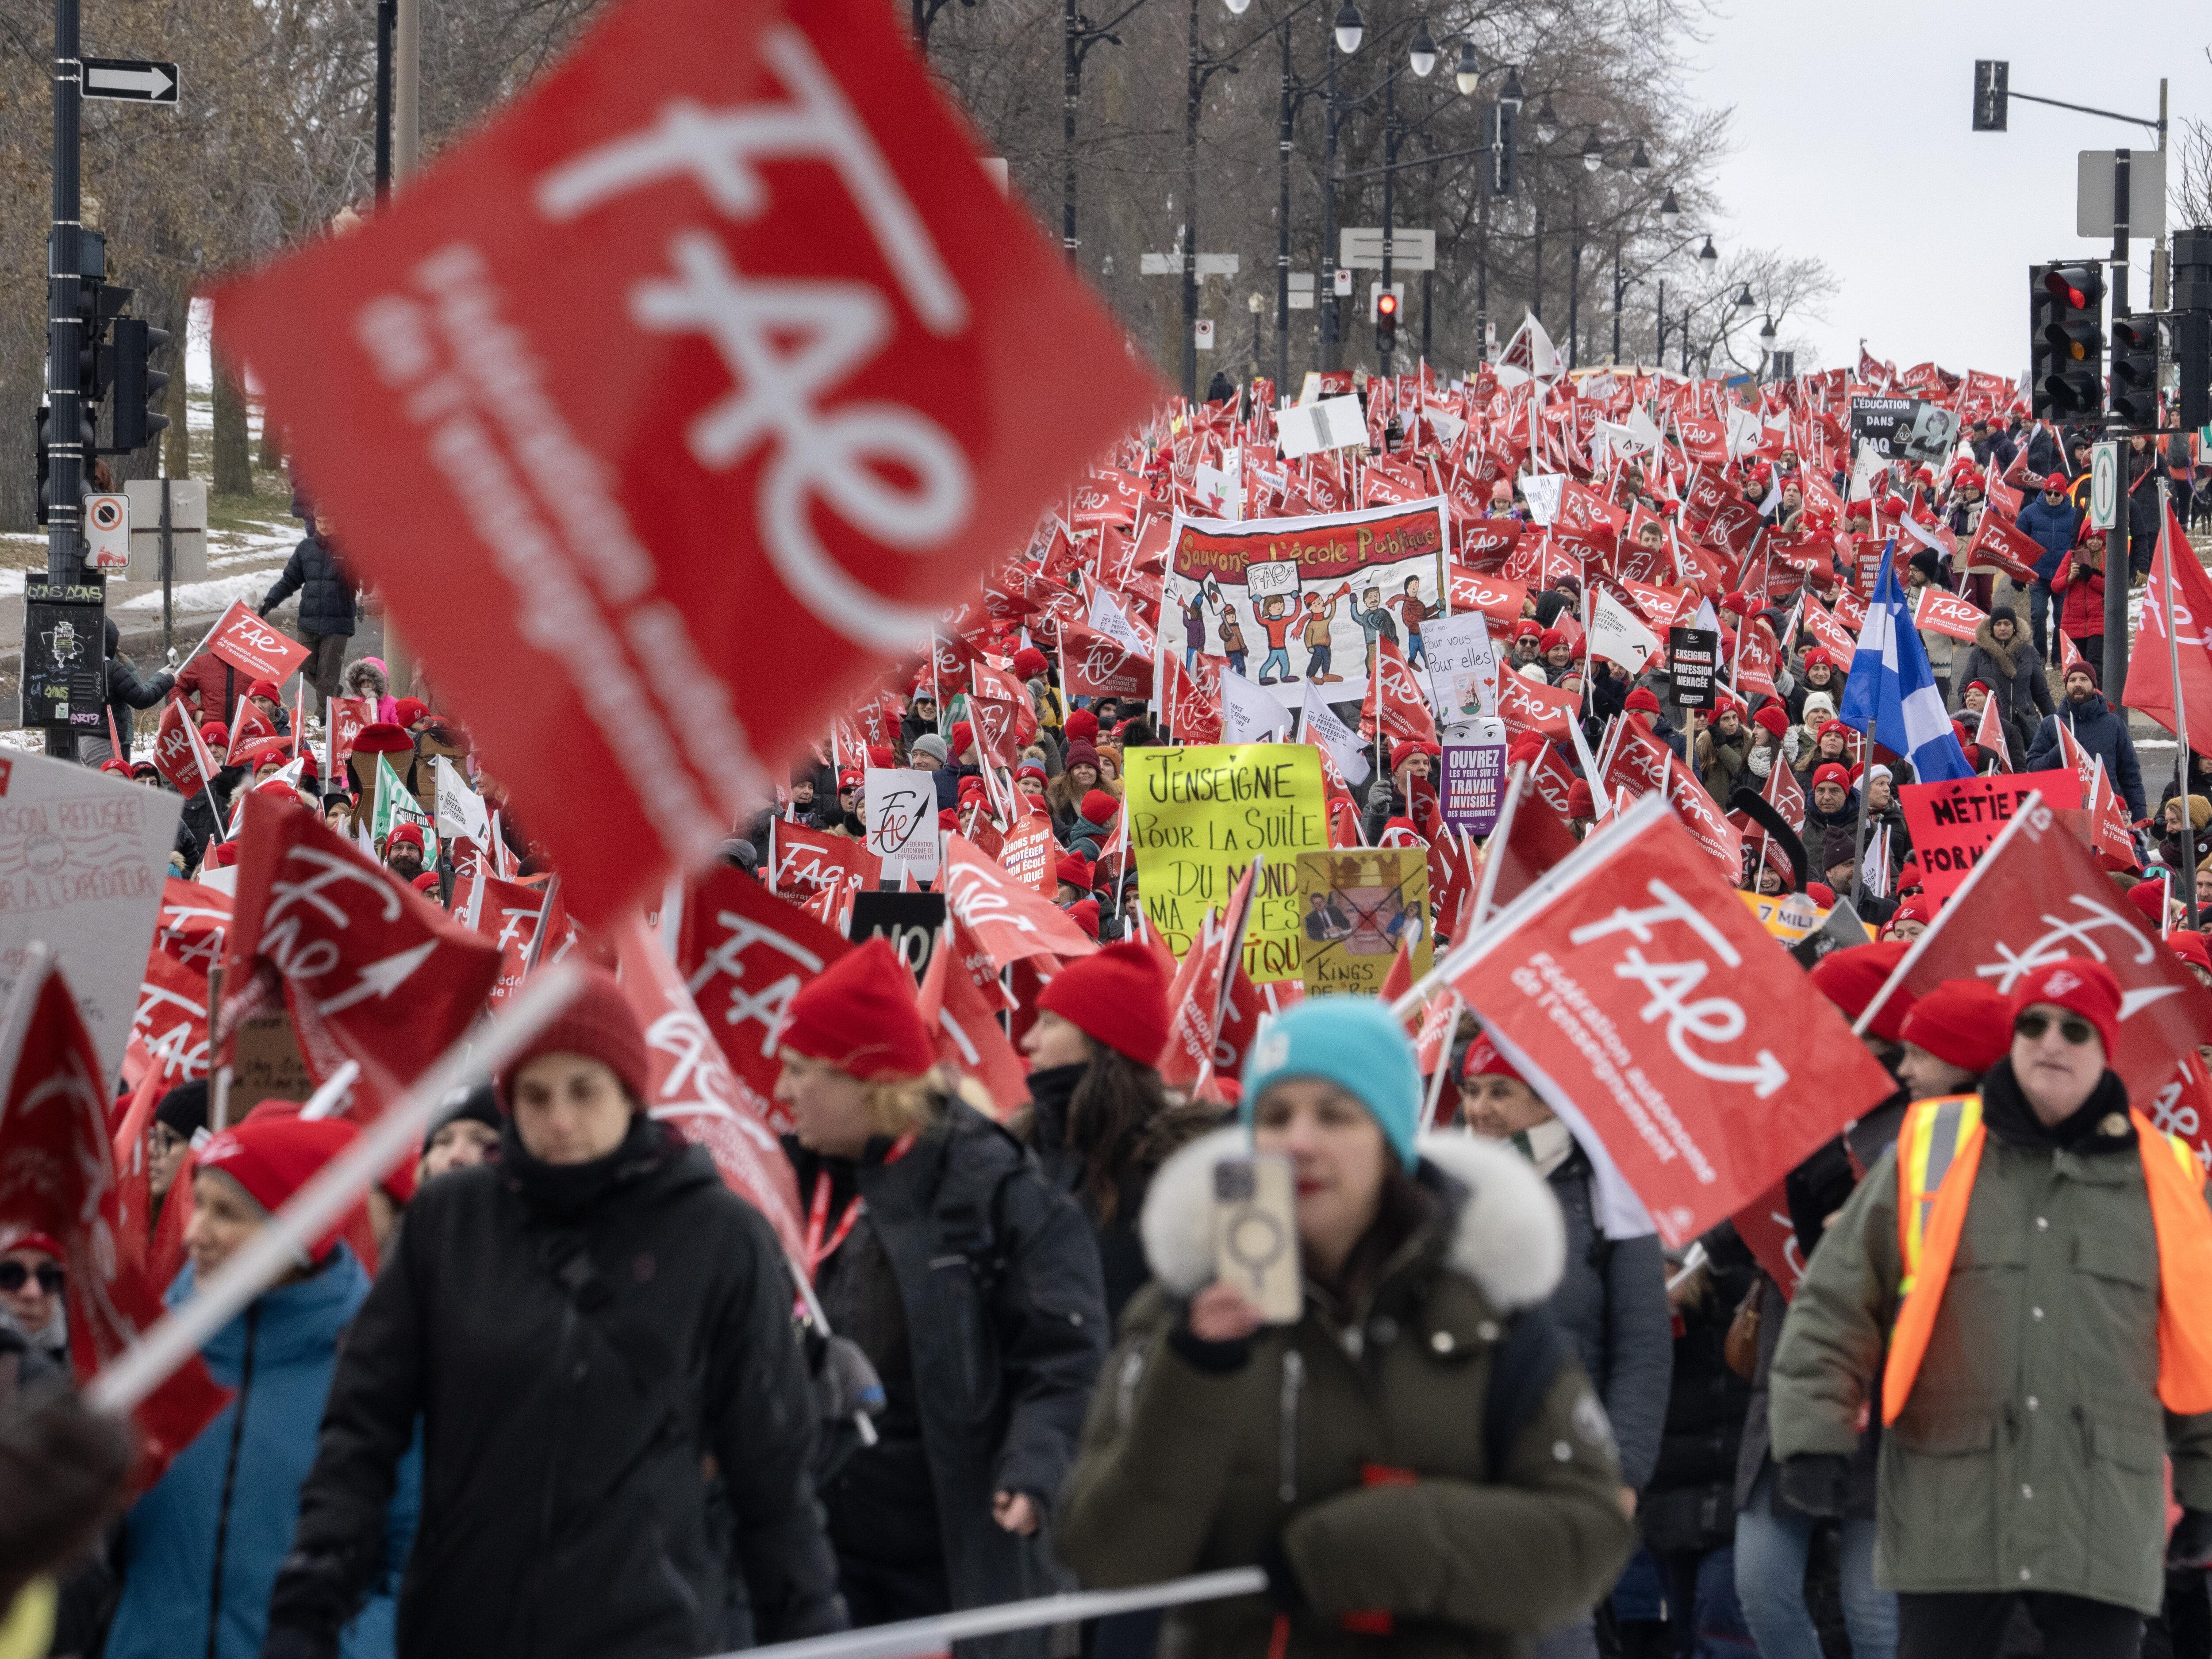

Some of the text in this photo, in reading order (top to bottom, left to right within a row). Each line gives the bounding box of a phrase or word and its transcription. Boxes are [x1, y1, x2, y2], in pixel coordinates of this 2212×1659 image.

[1853, 398, 1910, 410] L'ÉDUCATION
[1866, 416, 1894, 426] DANS
[1682, 422, 1716, 444] FAe
[1181, 534, 1250, 572] Sauvons
[1357, 527, 1435, 563] Publique
[1464, 528, 1506, 553] FAe
[1248, 564, 1294, 591] FAe
[1451, 576, 1505, 605] FAe
[1928, 597, 1982, 620] FAe
[227, 614, 287, 655] FAe
[961, 627, 985, 638] tonome
[1421, 624, 1434, 634] Pour
[1805, 606, 1848, 648] FAe
[1934, 620, 1976, 635] l'enseignemen
[1423, 635, 1471, 649] Pour vous
[219, 636, 280, 675] Fédération autonome
[226, 643, 270, 674] l'enseignement
[1428, 648, 1491, 673] Pour elles
[1676, 649, 1711, 662] ENSEIGNER
[1674, 663, 1712, 676] PROFESSION
[1677, 676, 1708, 688] MENACÉE
[1499, 678, 1557, 720] FAe
[1315, 724, 1347, 740] PROFESSEURS
[1450, 750, 1500, 768] OUVREZ
[1451, 779, 1496, 794] TRAVAIL
[1613, 768, 1644, 791] Fédération
[1450, 795, 1495, 808] INVISIBLE
[1671, 773, 1724, 834] FAe
[872, 791, 925, 853] FAe
[1134, 813, 1199, 849] POUR
[1210, 821, 1237, 850] LA
[2103, 820, 2130, 839] Fédérati
[1030, 828, 1049, 844] POUR
[1006, 844, 1043, 867] PROTÉGER
[1701, 834, 1735, 862] autonome
[1022, 855, 1045, 871] ÉCOLE
[1169, 861, 1297, 898] DU MOND
[1151, 895, 1183, 929] MA
[1761, 905, 1772, 920] 7
[689, 911, 823, 1057] FA
[1571, 879, 1765, 1088] FAe
[1511, 967, 1678, 1164] de l'enseignement
[1529, 952, 1716, 1183] Fédération autonome
